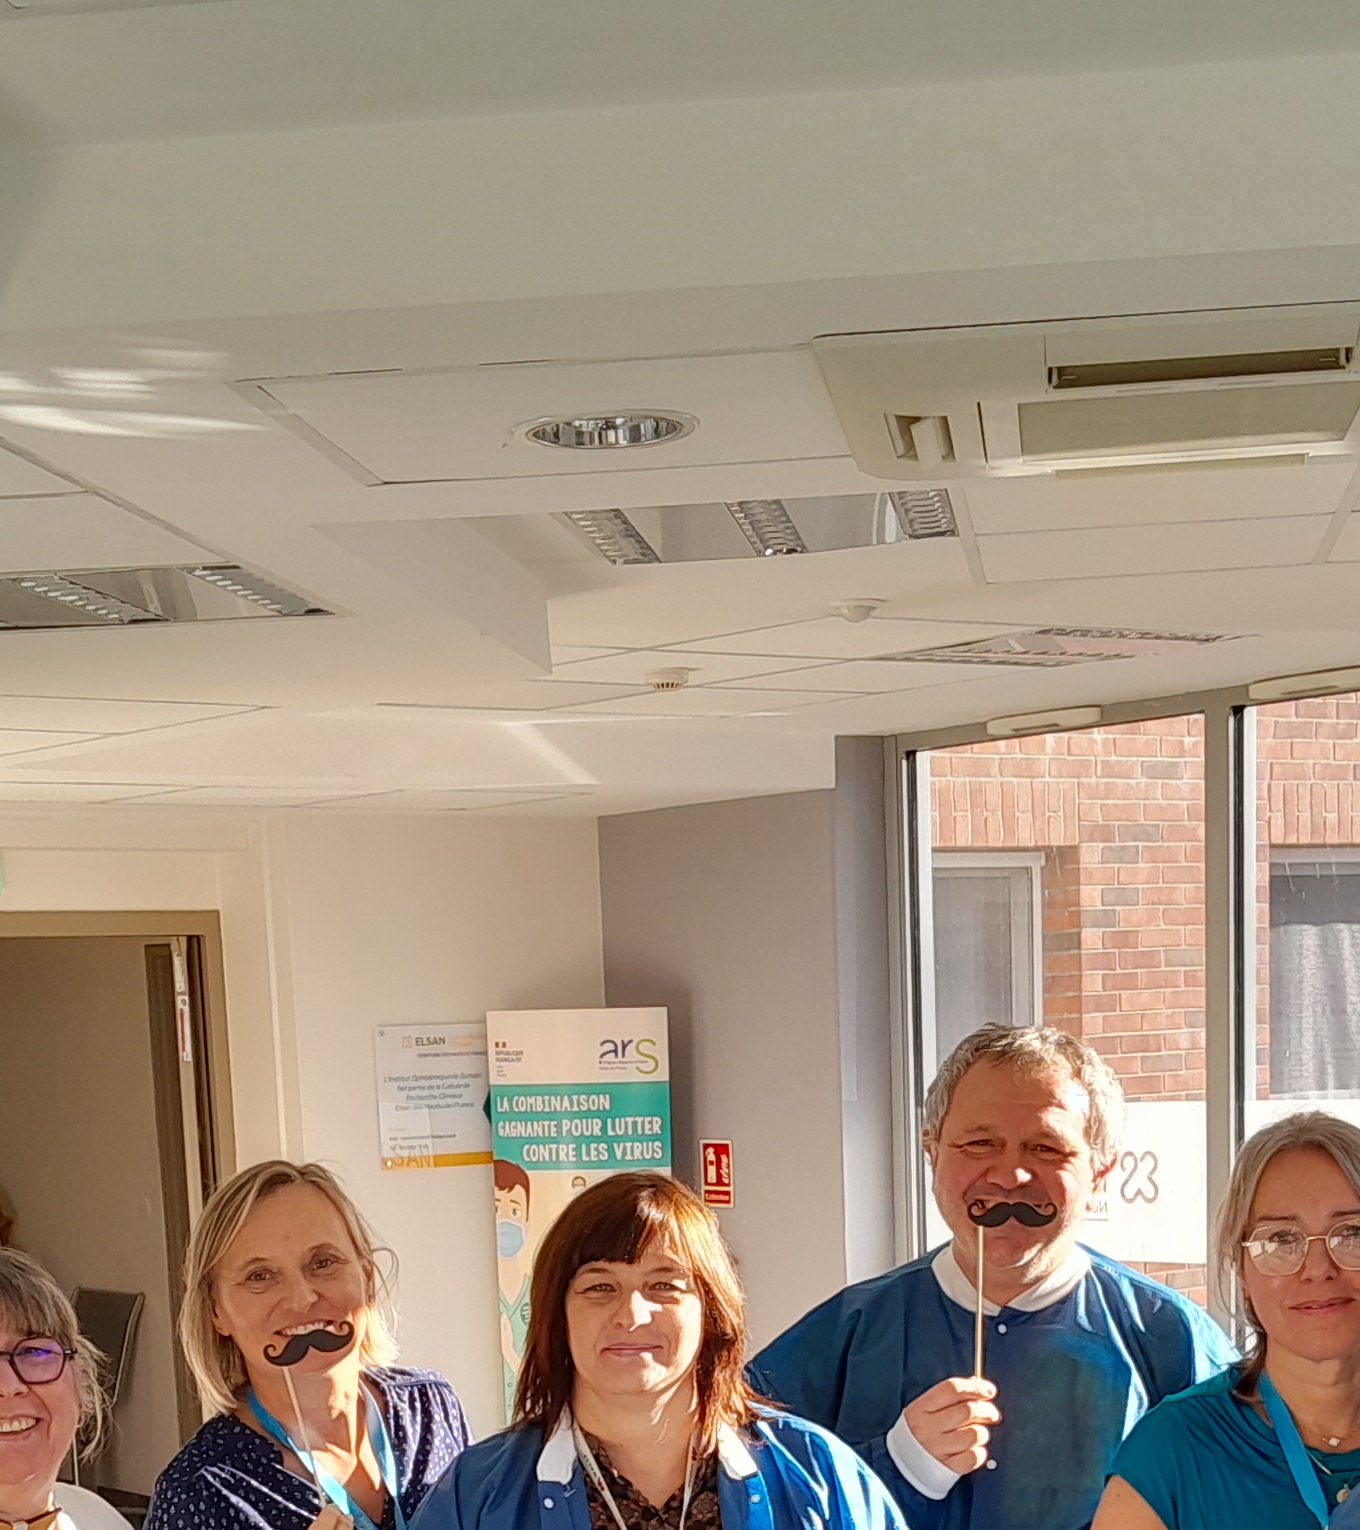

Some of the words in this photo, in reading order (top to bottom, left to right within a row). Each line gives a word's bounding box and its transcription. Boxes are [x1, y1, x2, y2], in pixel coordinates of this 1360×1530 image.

[415, 1036, 446, 1047] ELSAN
[496, 1096, 510, 1112] LA
[512, 1094, 611, 1112] COMBINAISON
[497, 1120, 558, 1138] GAGNANTE
[562, 1118, 603, 1137] POUR
[607, 1116, 662, 1136] LUTTER
[522, 1143, 577, 1162] CONTRE
[581, 1143, 609, 1162] LES
[613, 1141, 663, 1161] VIRUS
